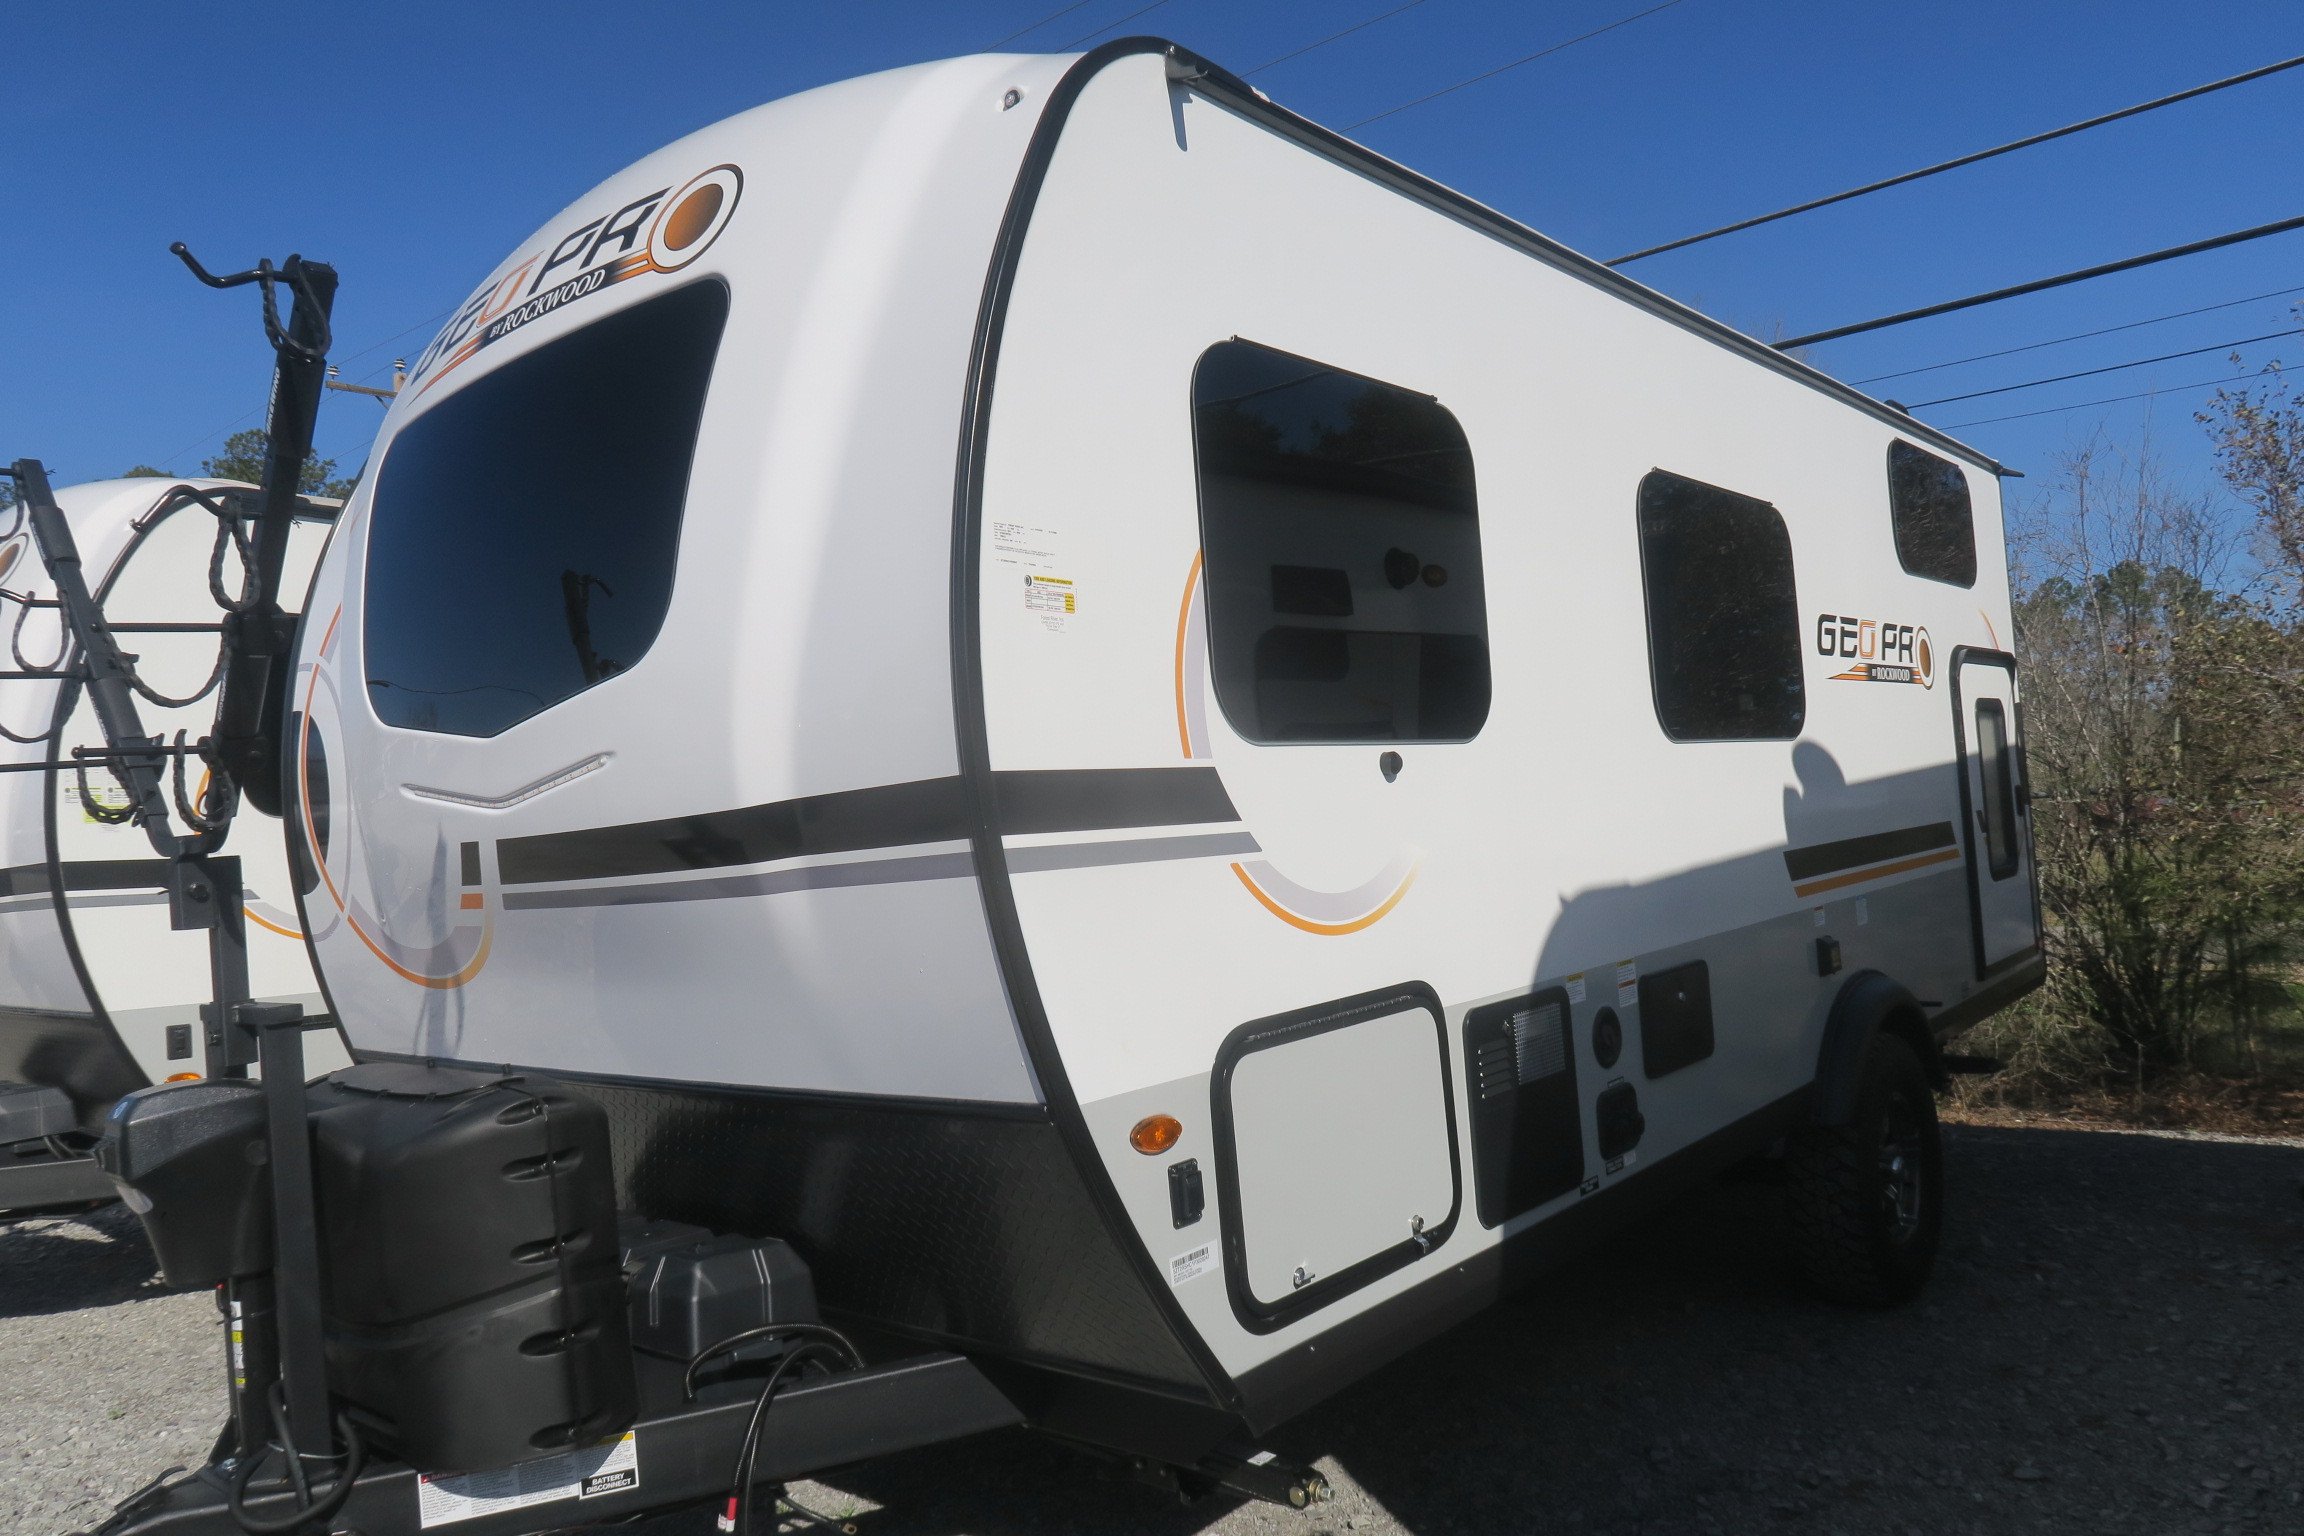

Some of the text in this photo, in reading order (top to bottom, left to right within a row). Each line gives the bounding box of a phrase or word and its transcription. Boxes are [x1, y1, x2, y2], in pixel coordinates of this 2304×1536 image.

[489, 269, 606, 338] BY ROCKWOOD
[1876, 666, 1911, 682] ROCKWOOD
[586, 1478, 632, 1494] DISCONNECT
[592, 1473, 625, 1486] BATTERY
